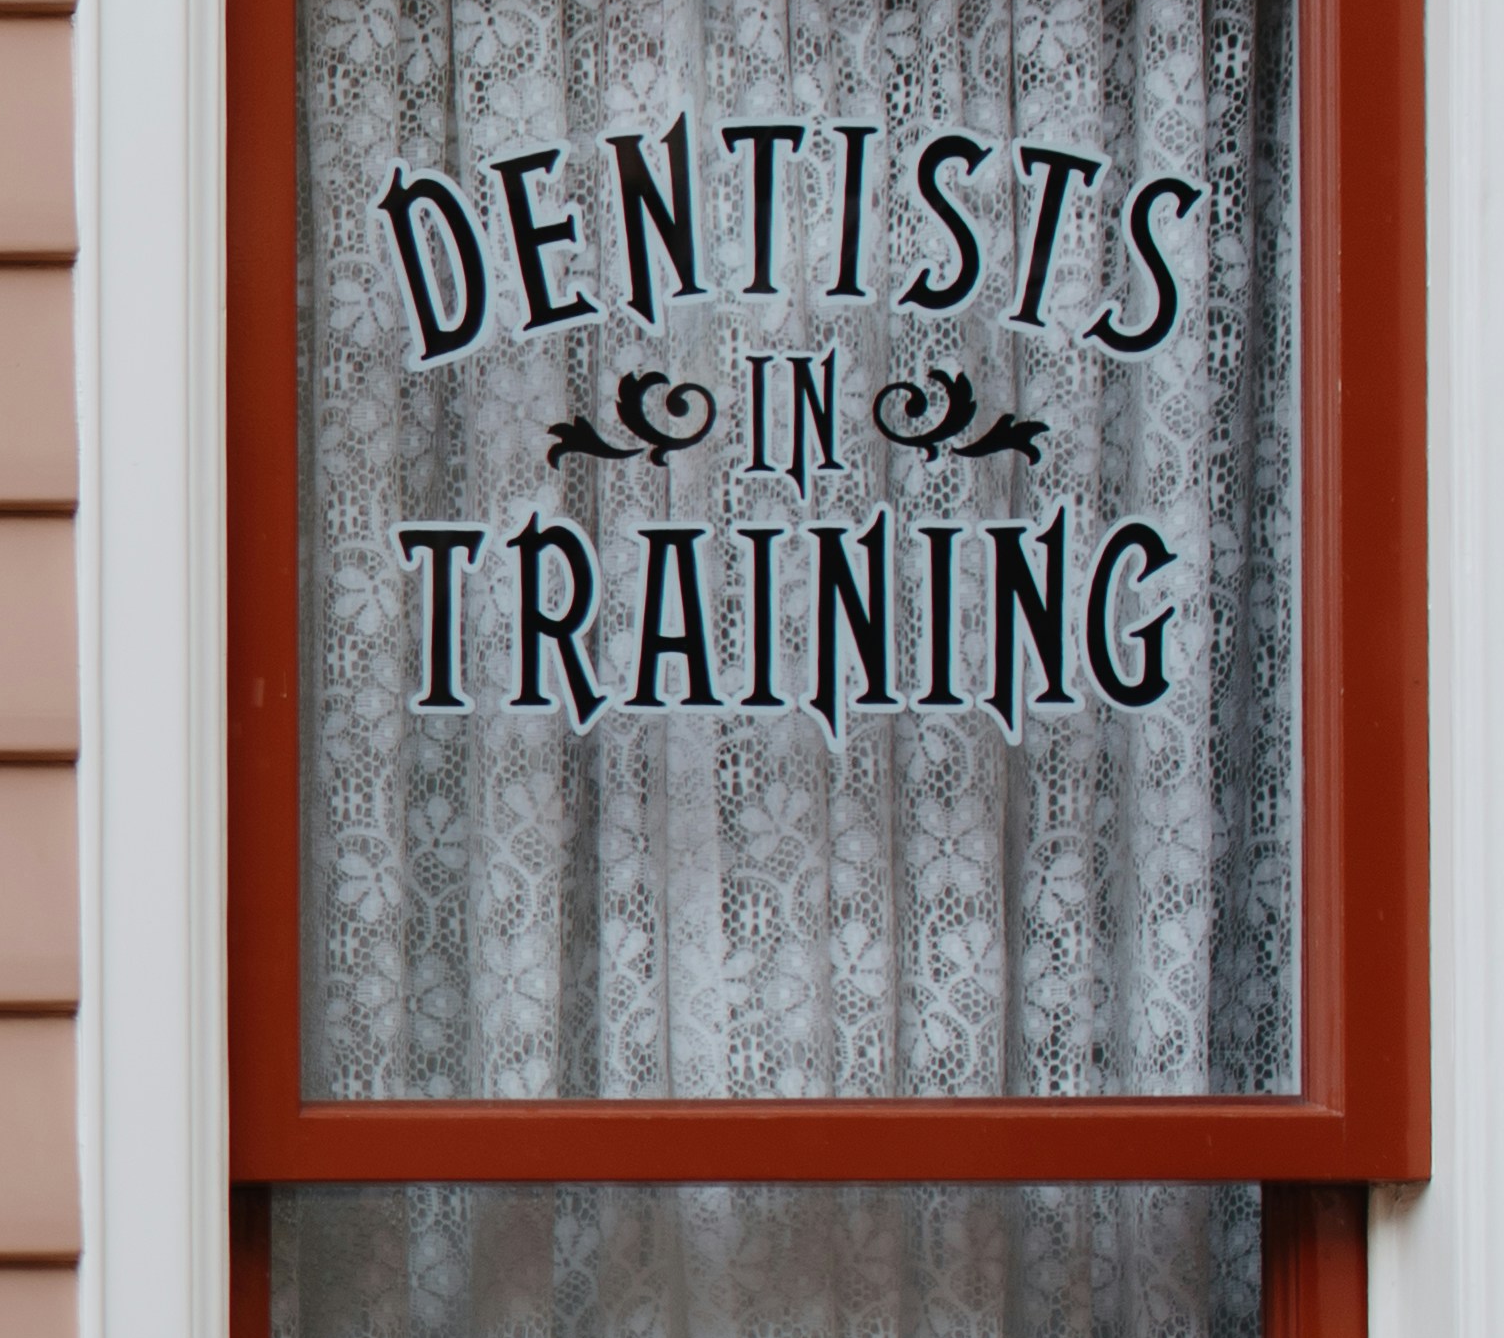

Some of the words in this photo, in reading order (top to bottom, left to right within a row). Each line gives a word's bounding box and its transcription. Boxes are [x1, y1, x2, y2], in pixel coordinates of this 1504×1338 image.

[377, 109, 1204, 363] DENTISTS
[743, 347, 848, 501] IN
[397, 504, 1179, 741] TRAINING
